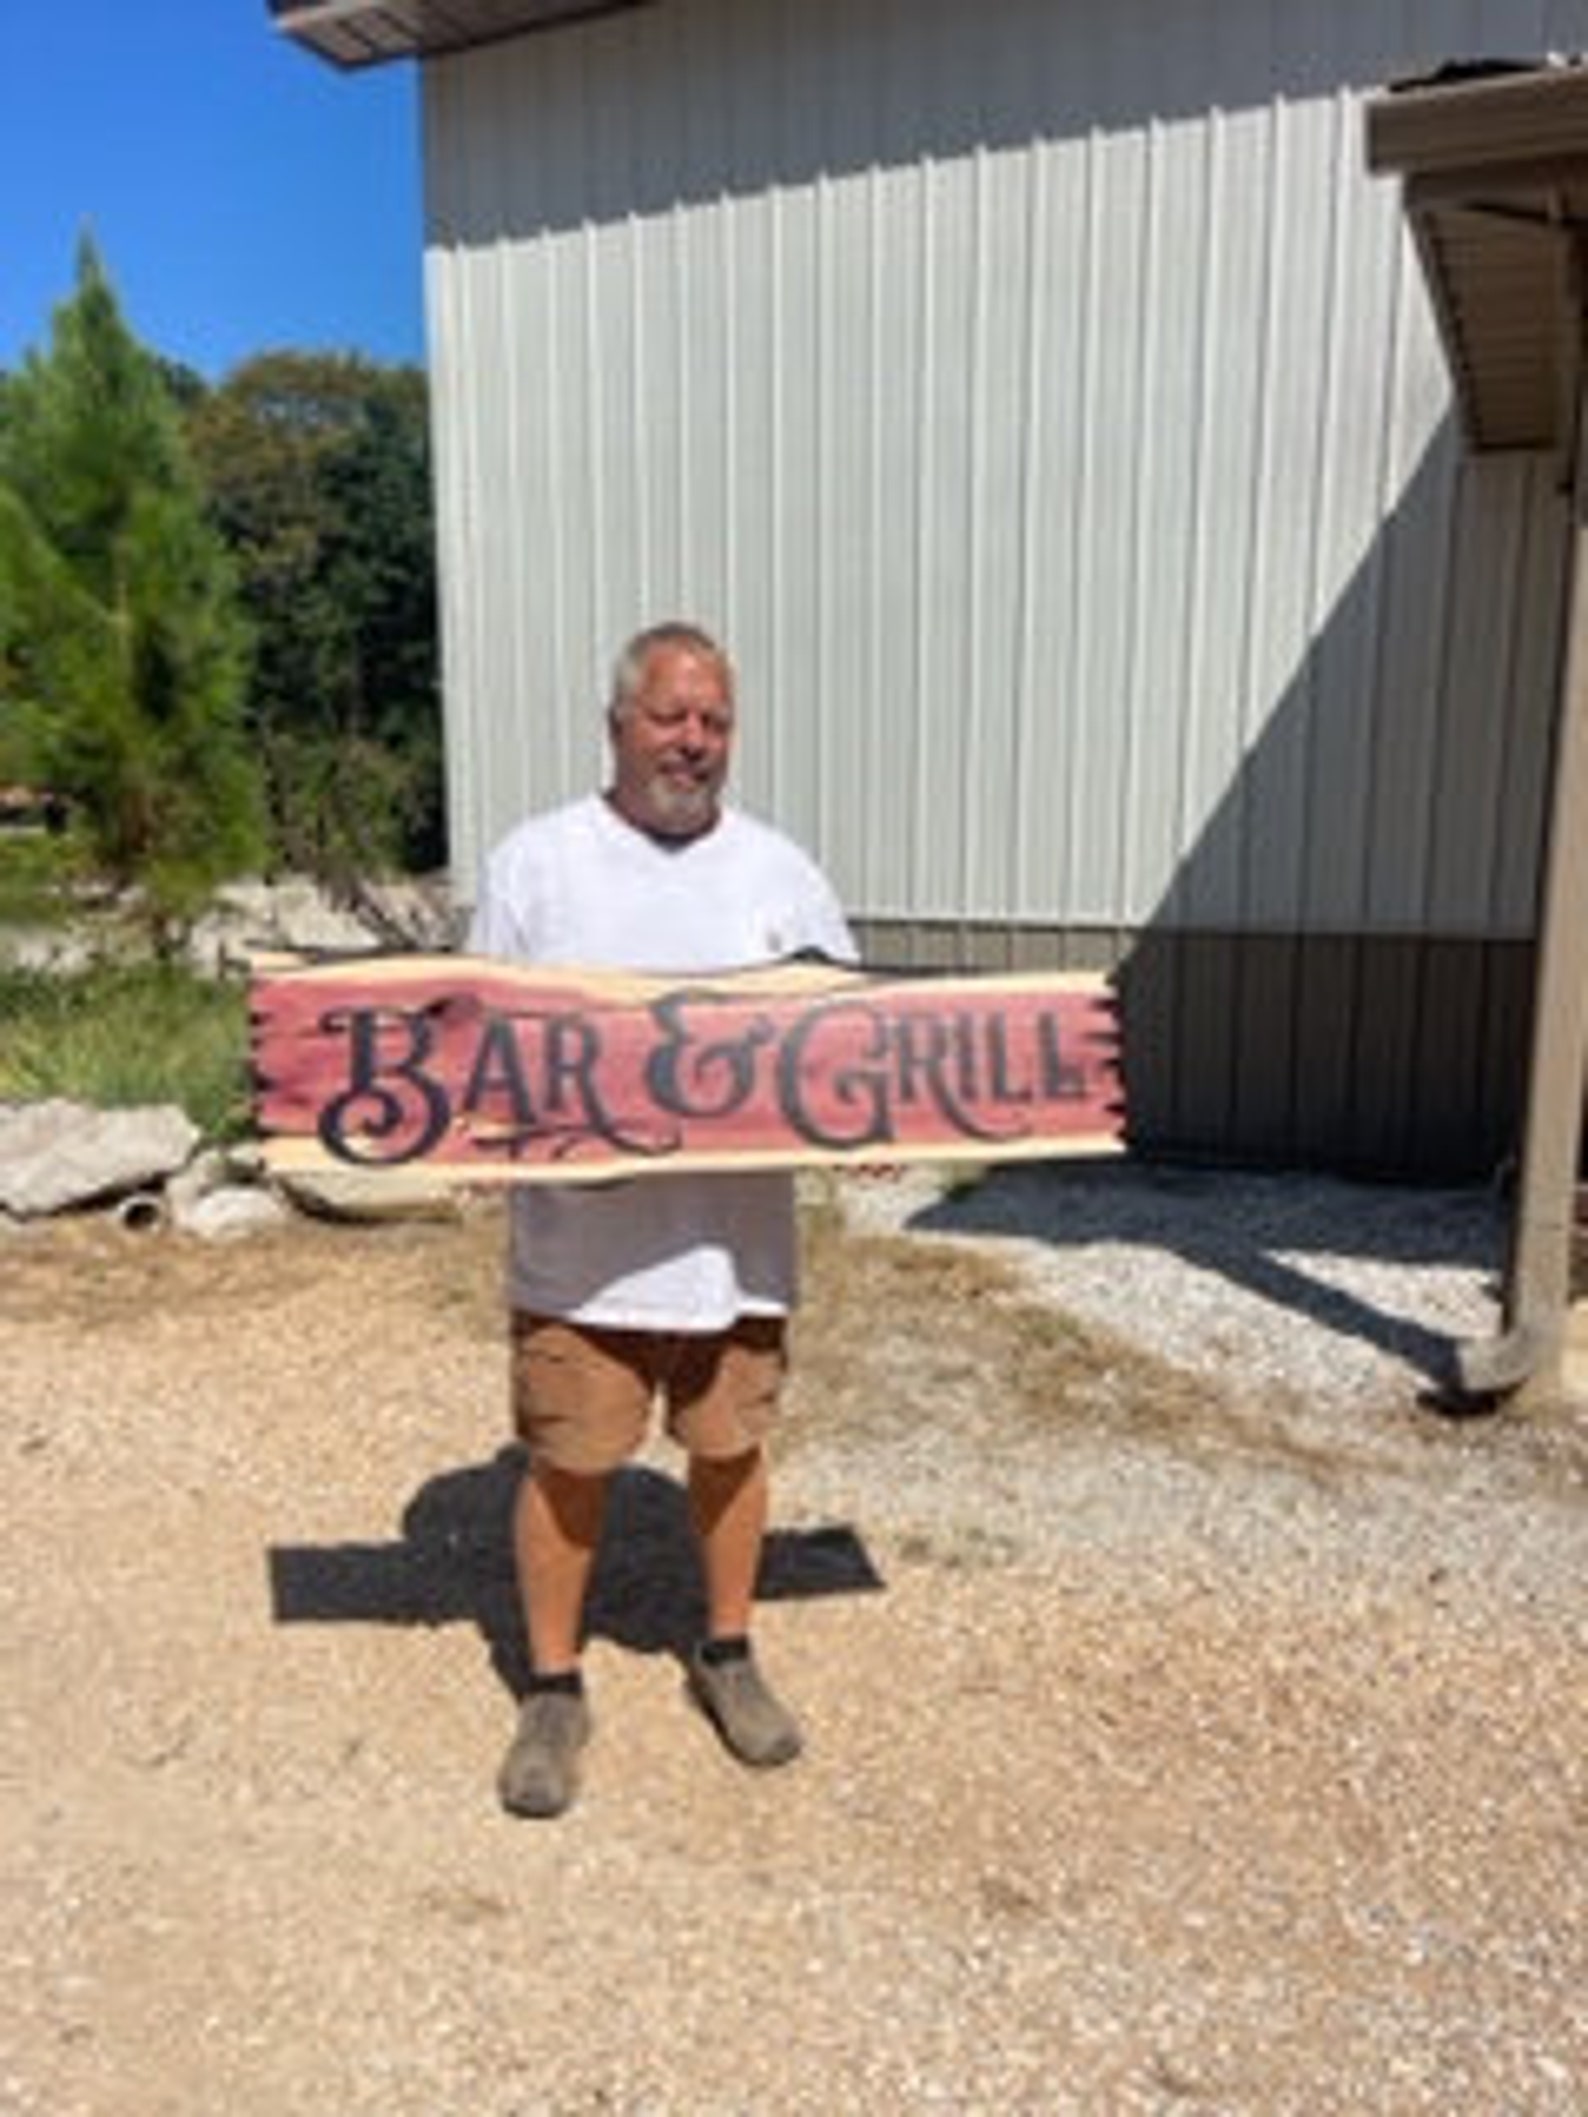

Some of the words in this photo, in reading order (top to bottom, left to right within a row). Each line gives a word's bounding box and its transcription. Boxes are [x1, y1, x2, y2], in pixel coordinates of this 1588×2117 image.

[319, 1002, 682, 1165] BAR
[645, 989, 773, 1118] &
[780, 1000, 1086, 1149] GRILL
